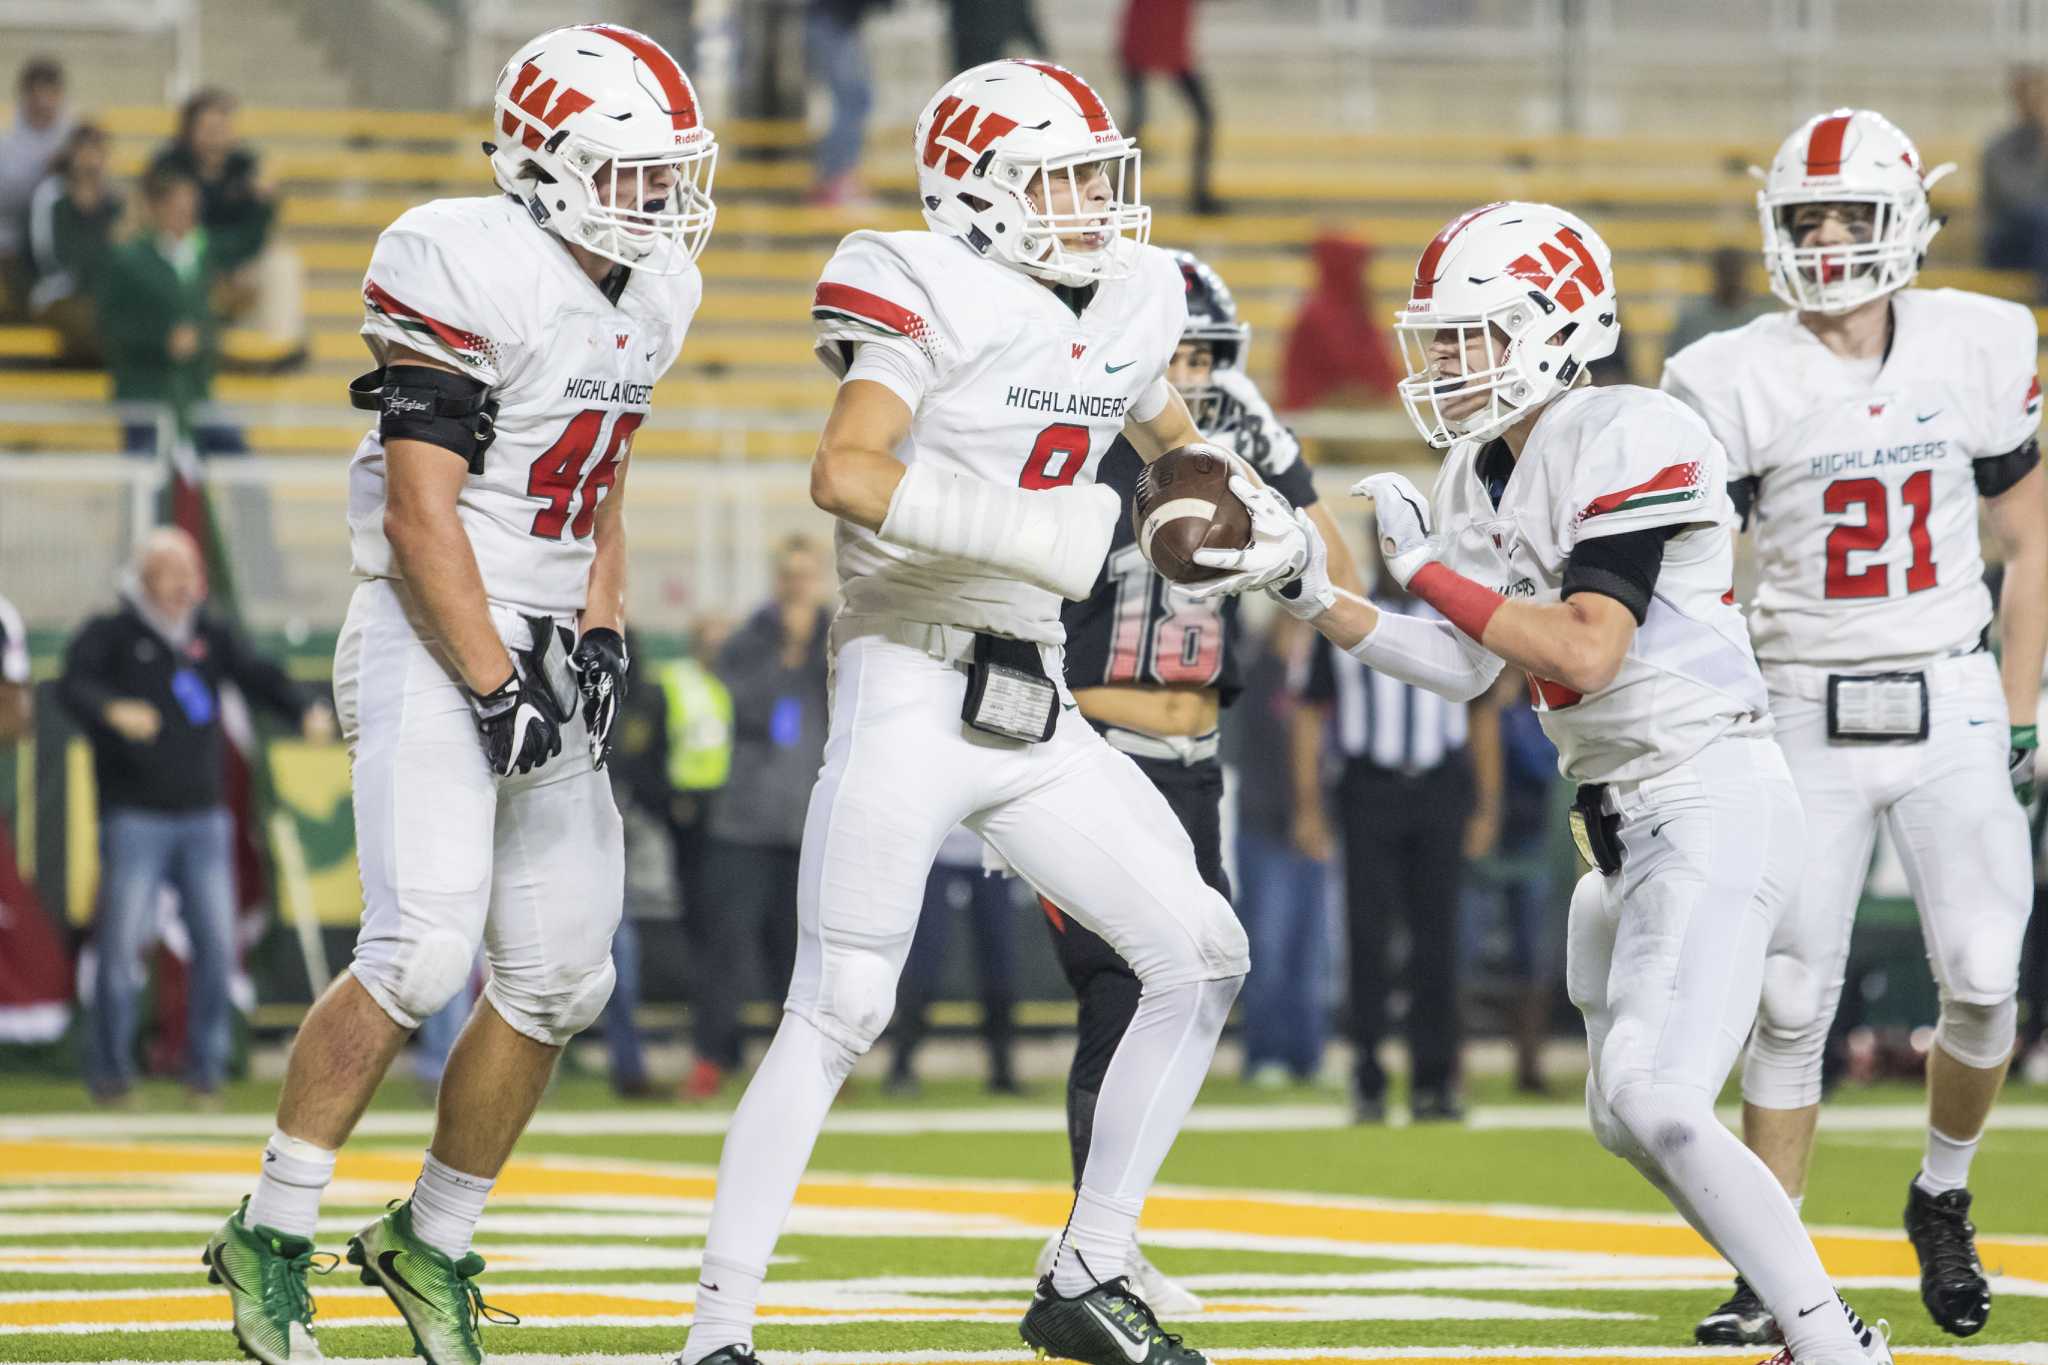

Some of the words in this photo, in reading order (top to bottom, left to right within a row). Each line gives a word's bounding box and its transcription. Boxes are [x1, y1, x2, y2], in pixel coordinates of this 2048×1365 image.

[616, 334, 629, 349] W
[1071, 343, 1087, 359] W
[1005, 386, 1128, 418] HIGHLANDERS
[1808, 440, 1947, 477] HIGHLANDERS
[1823, 469, 1938, 600] 21
[1104, 543, 1224, 687] 18
